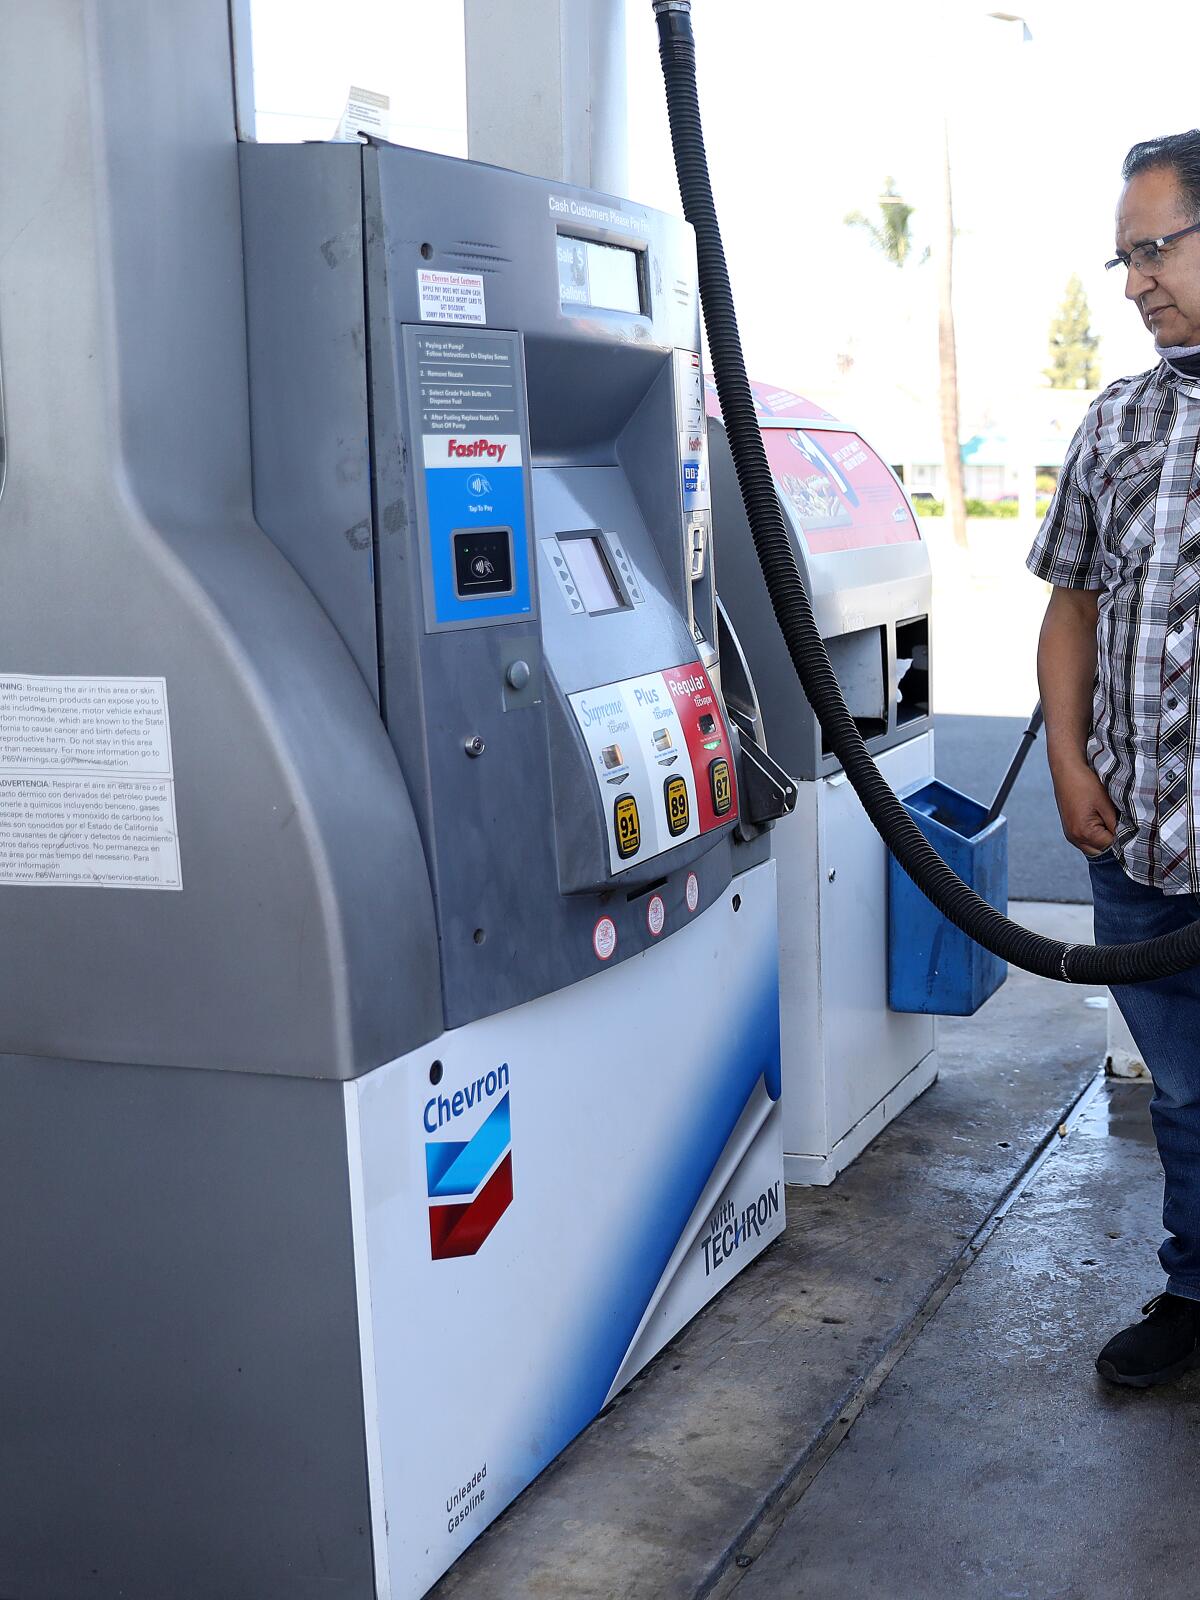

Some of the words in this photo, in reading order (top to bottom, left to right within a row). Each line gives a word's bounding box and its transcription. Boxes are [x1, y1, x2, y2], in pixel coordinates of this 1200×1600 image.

[549, 197, 569, 213] Cash
[570, 202, 609, 221] Customers
[448, 439, 506, 462] FastPay
[484, 505, 493, 513] Pay
[27, 684, 62, 694] Breathing
[669, 675, 705, 697] Regular
[2, 693, 17, 701] with
[20, 694, 57, 704] petroleum
[60, 696, 91, 705] products
[634, 688, 659, 706] Plus
[694, 696, 713, 707] TECHRON
[13, 703, 46, 713] including
[48, 705, 81, 714] benzene,
[581, 700, 623, 727] Supreme
[19, 714, 58, 723] monoxide,
[96, 717, 120, 725] known
[96, 738, 111, 746] stay
[97, 748, 139, 756] information
[53, 781, 82, 790] Respirar
[716, 776, 728, 798] 87
[18, 790, 46, 798] dérmico
[64, 791, 98, 799] derivados
[113, 793, 142, 802] petróleo
[145, 793, 167, 802] puede
[64, 801, 103, 811] incluyendo
[105, 803, 137, 811] benceno,
[671, 794, 685, 818] 89
[36, 811, 64, 819] motores
[73, 812, 109, 820] monóxido
[122, 813, 150, 821] carbono
[88, 822, 111, 830] Estado
[620, 814, 637, 838] 91
[133, 834, 173, 842] nacimiento
[106, 845, 149, 853] permanezca
[56, 852, 80, 861] tiempo
[423, 1062, 509, 1134] Chevron
[710, 1200, 735, 1234] with
[701, 1181, 780, 1276] TECHRON
[446, 1462, 487, 1512] Unleaded
[448, 1490, 485, 1533] Gasoline
